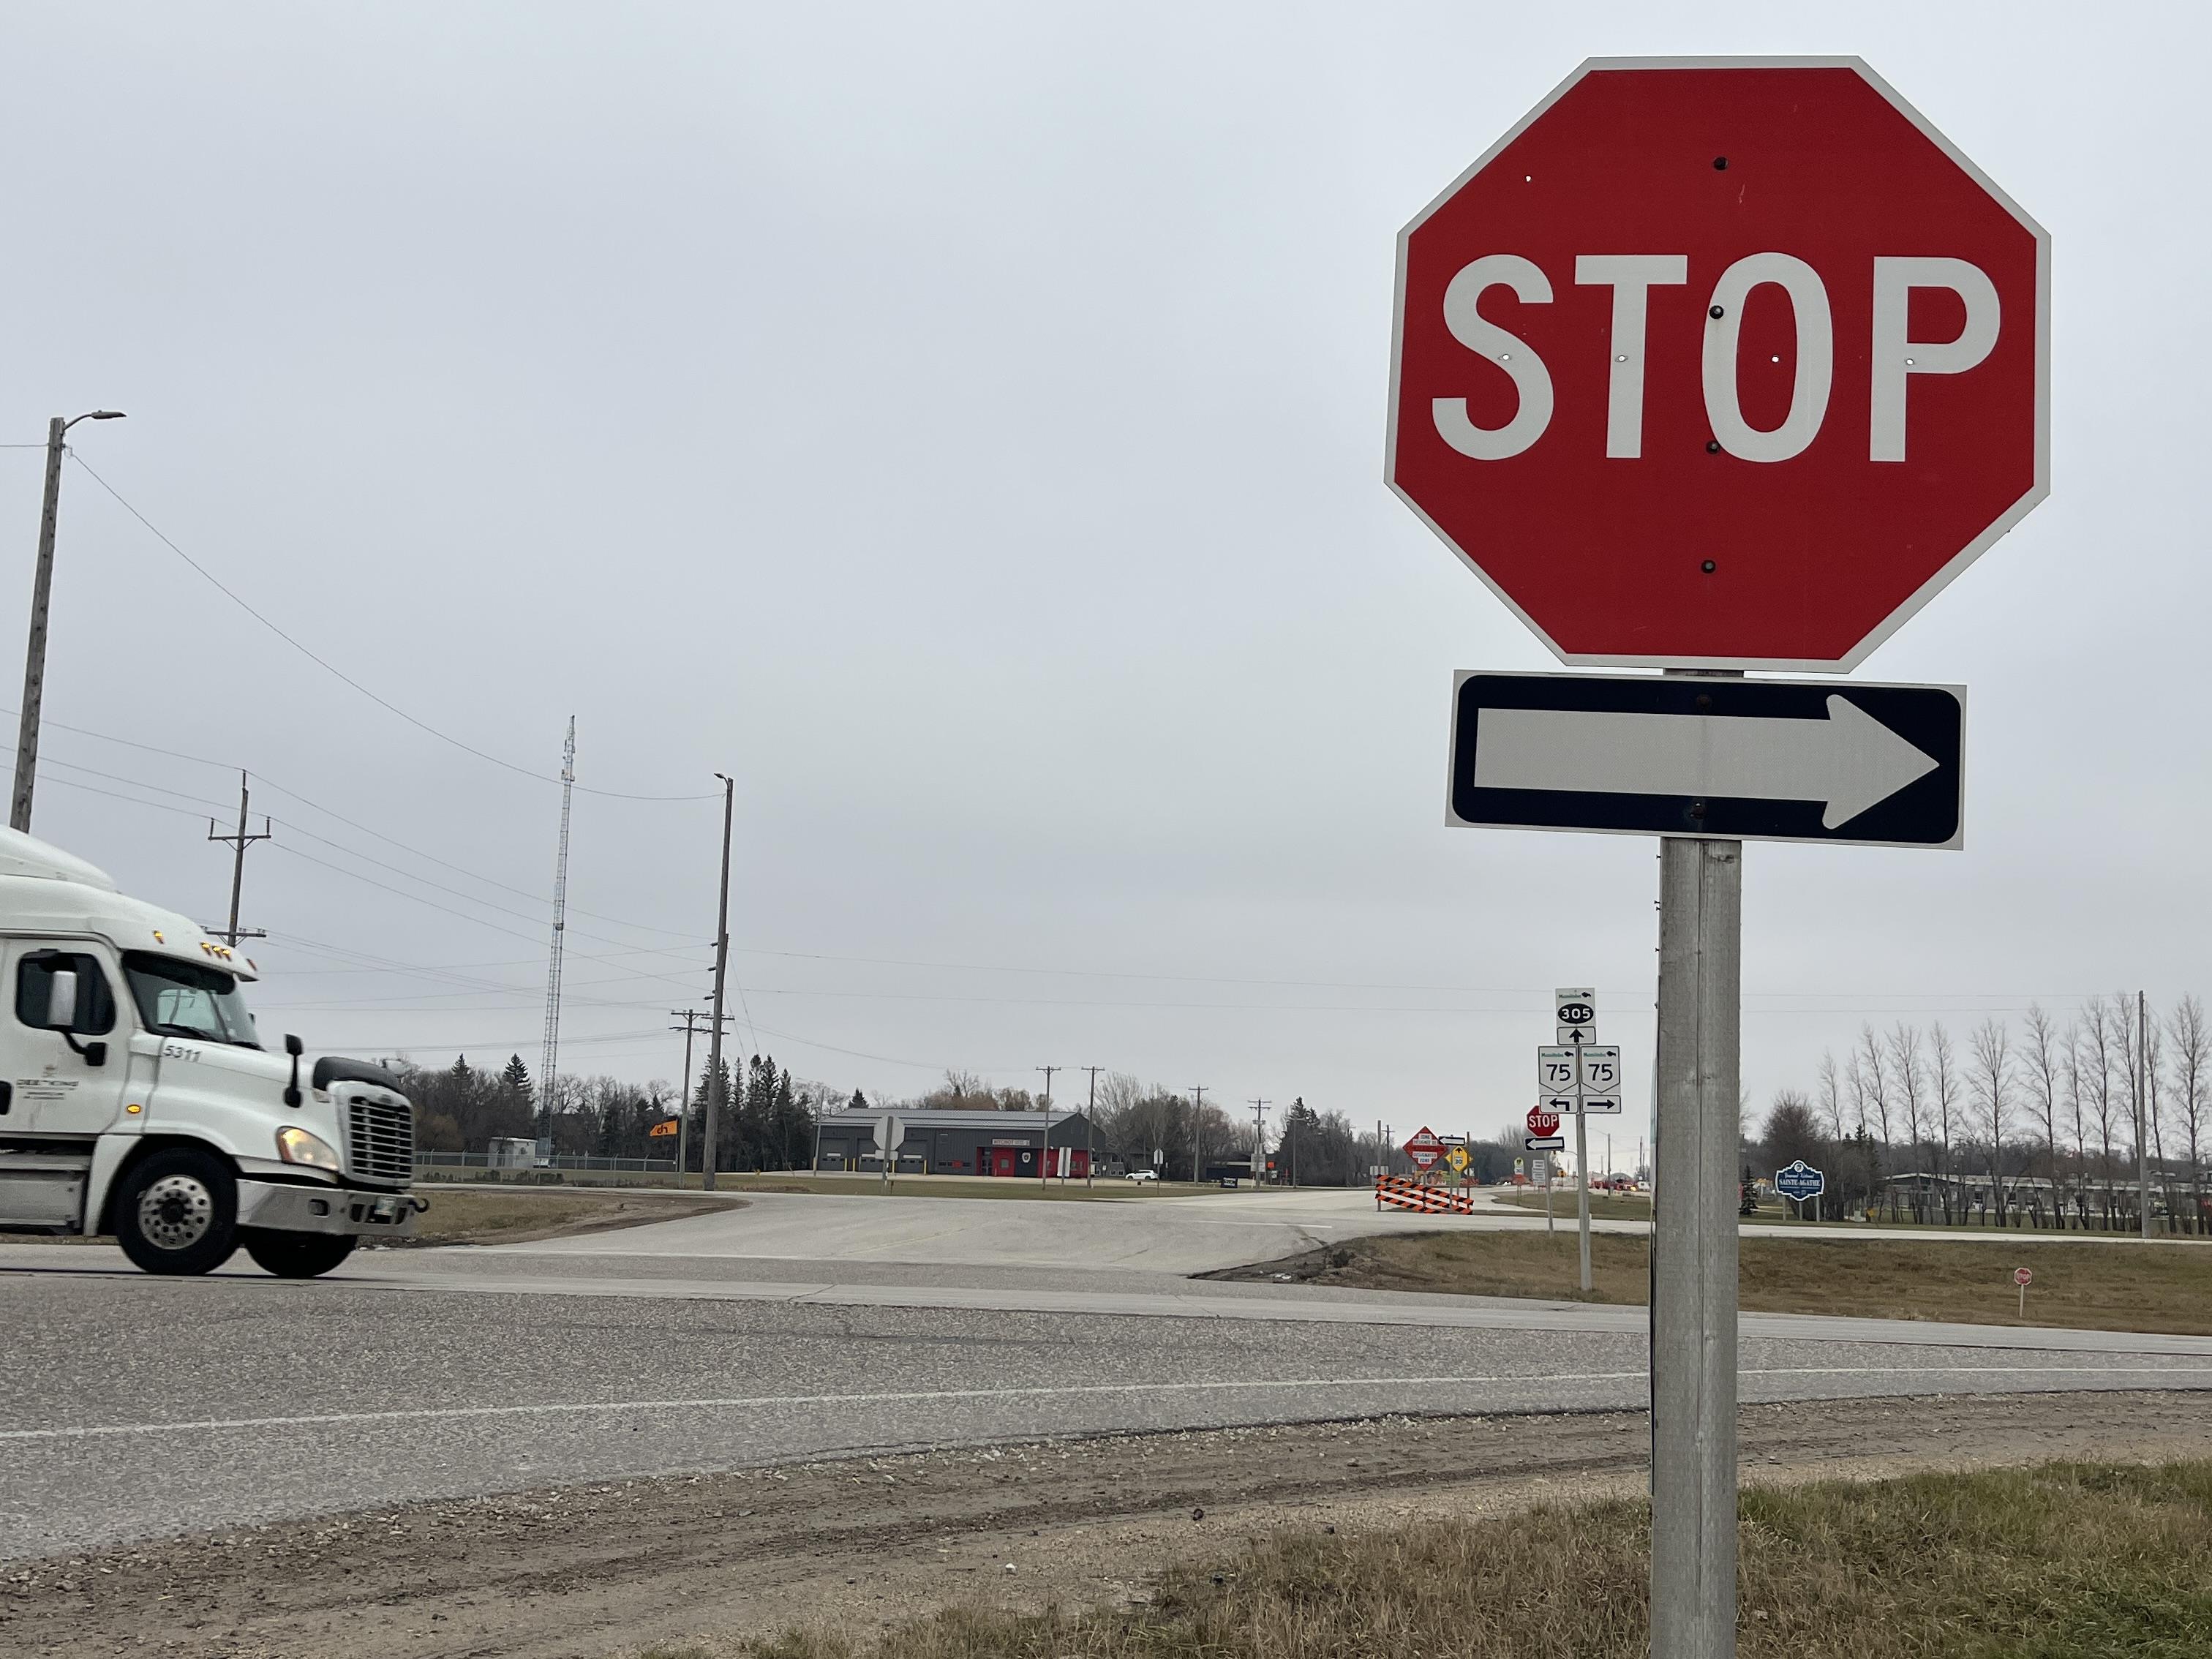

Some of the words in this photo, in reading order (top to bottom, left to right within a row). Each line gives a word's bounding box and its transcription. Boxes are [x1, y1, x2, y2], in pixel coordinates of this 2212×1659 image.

[1431, 252, 2001, 463] STOP
[1562, 1008, 1591, 1020] 305
[162, 1045, 203, 1062] 5311
[1546, 1064, 1570, 1081] 75
[1588, 1064, 1613, 1081] 75
[1529, 1115, 1558, 1127] STOP
